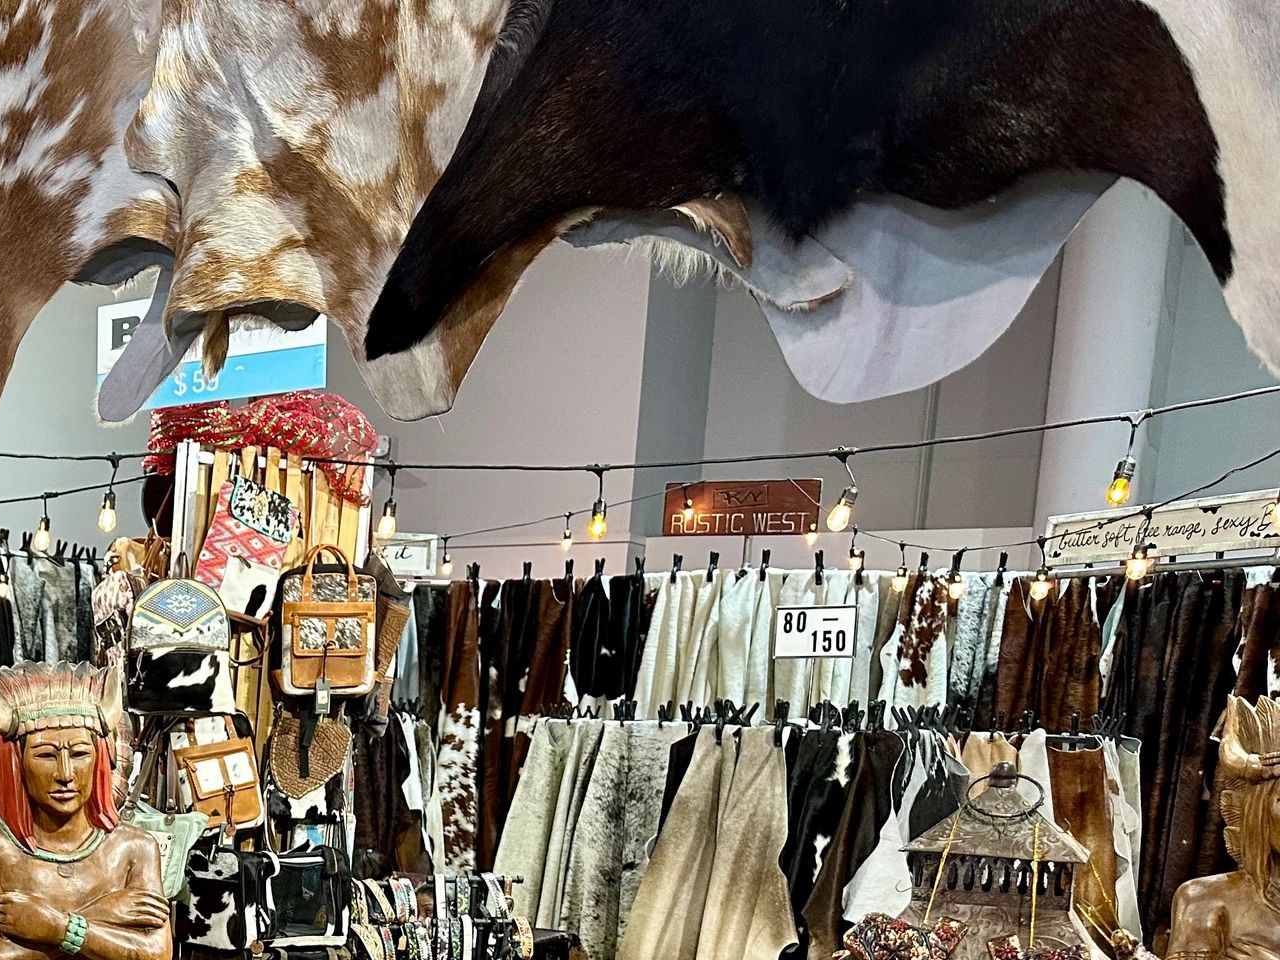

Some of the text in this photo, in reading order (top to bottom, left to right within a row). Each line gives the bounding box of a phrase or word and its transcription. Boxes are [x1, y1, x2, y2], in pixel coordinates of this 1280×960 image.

[671, 511, 810, 534] RUSTIC WEST
[1058, 530, 1100, 550] butter
[1211, 514, 1259, 537] sexy
[783, 611, 807, 633] 80
[811, 630, 846, 652] 150
